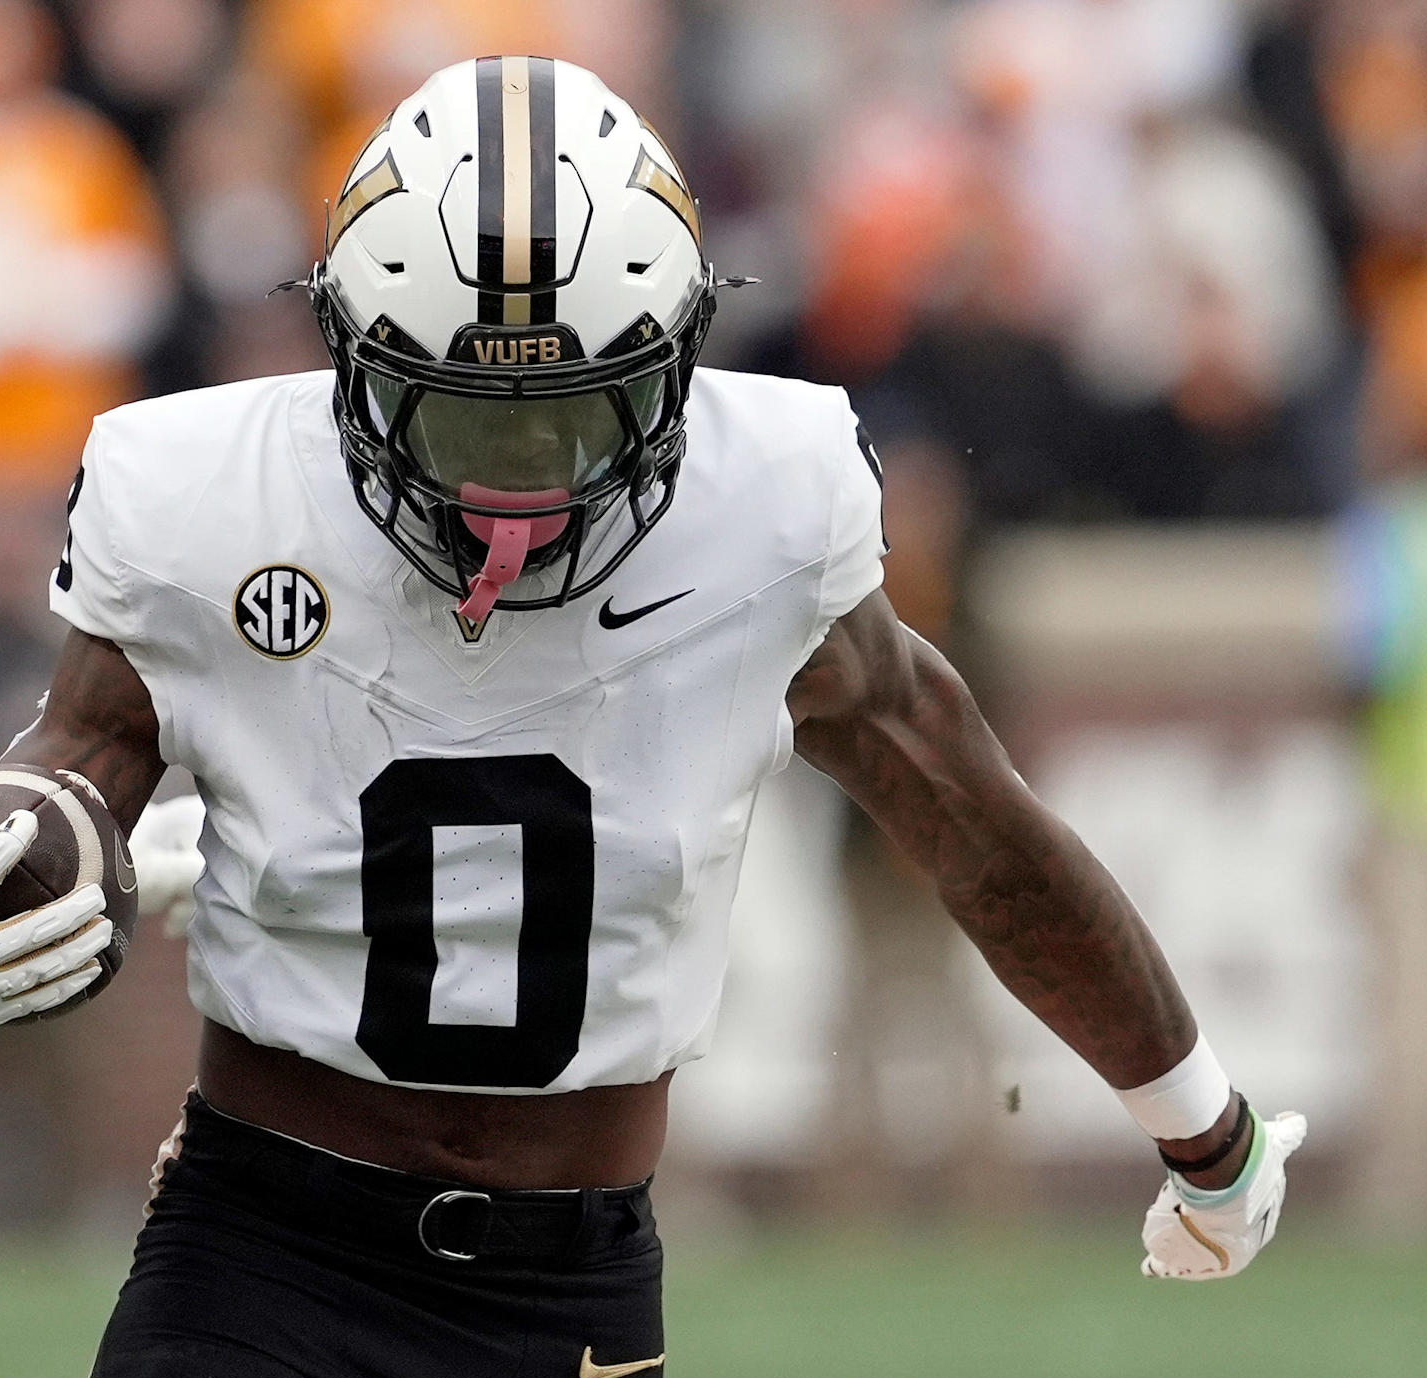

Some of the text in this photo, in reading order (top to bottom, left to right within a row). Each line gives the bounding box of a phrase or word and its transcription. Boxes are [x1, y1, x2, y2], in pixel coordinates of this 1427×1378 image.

[474, 337, 560, 364] VUFB
[240, 569, 322, 654] SEC
[355, 754, 594, 1088] 0
